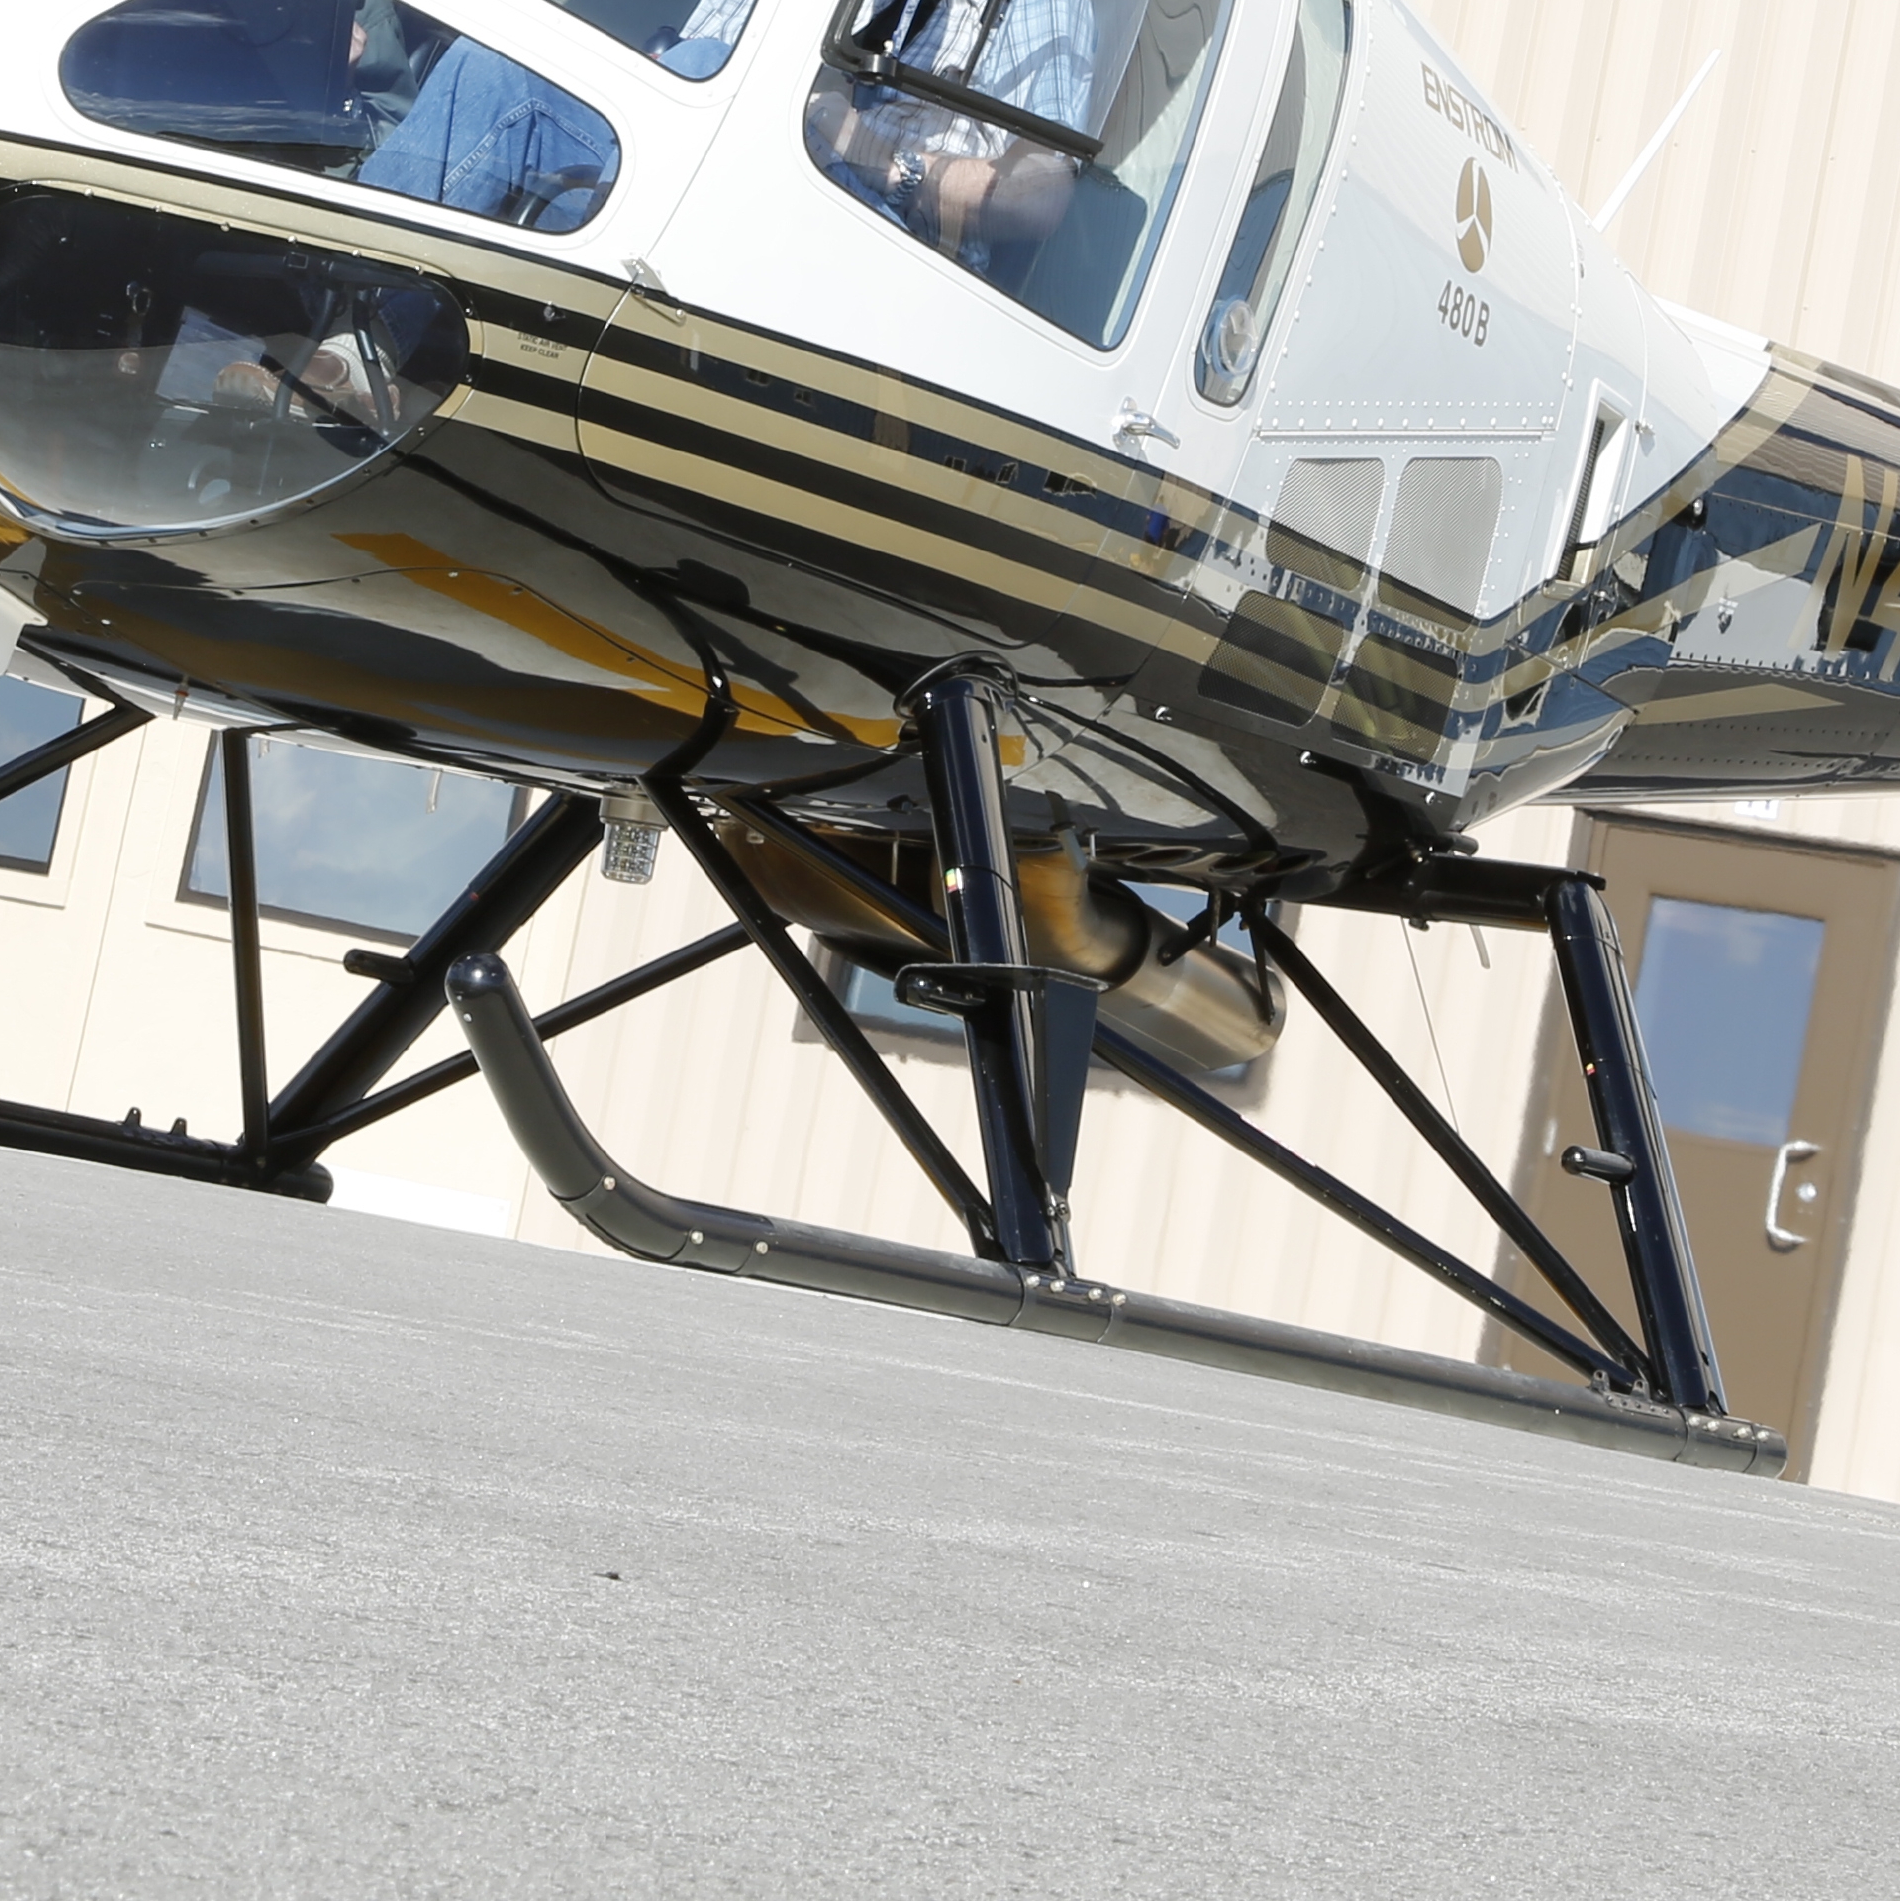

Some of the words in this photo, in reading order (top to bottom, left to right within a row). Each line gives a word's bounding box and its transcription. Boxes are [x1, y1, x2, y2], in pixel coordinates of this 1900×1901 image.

[1420, 61, 1519, 174] ENSTROM
[1437, 280, 1490, 347] 480B
[517, 331, 538, 345] STATIC
[520, 343, 537, 352] KEEP
[538, 348, 559, 359] CLEAR
